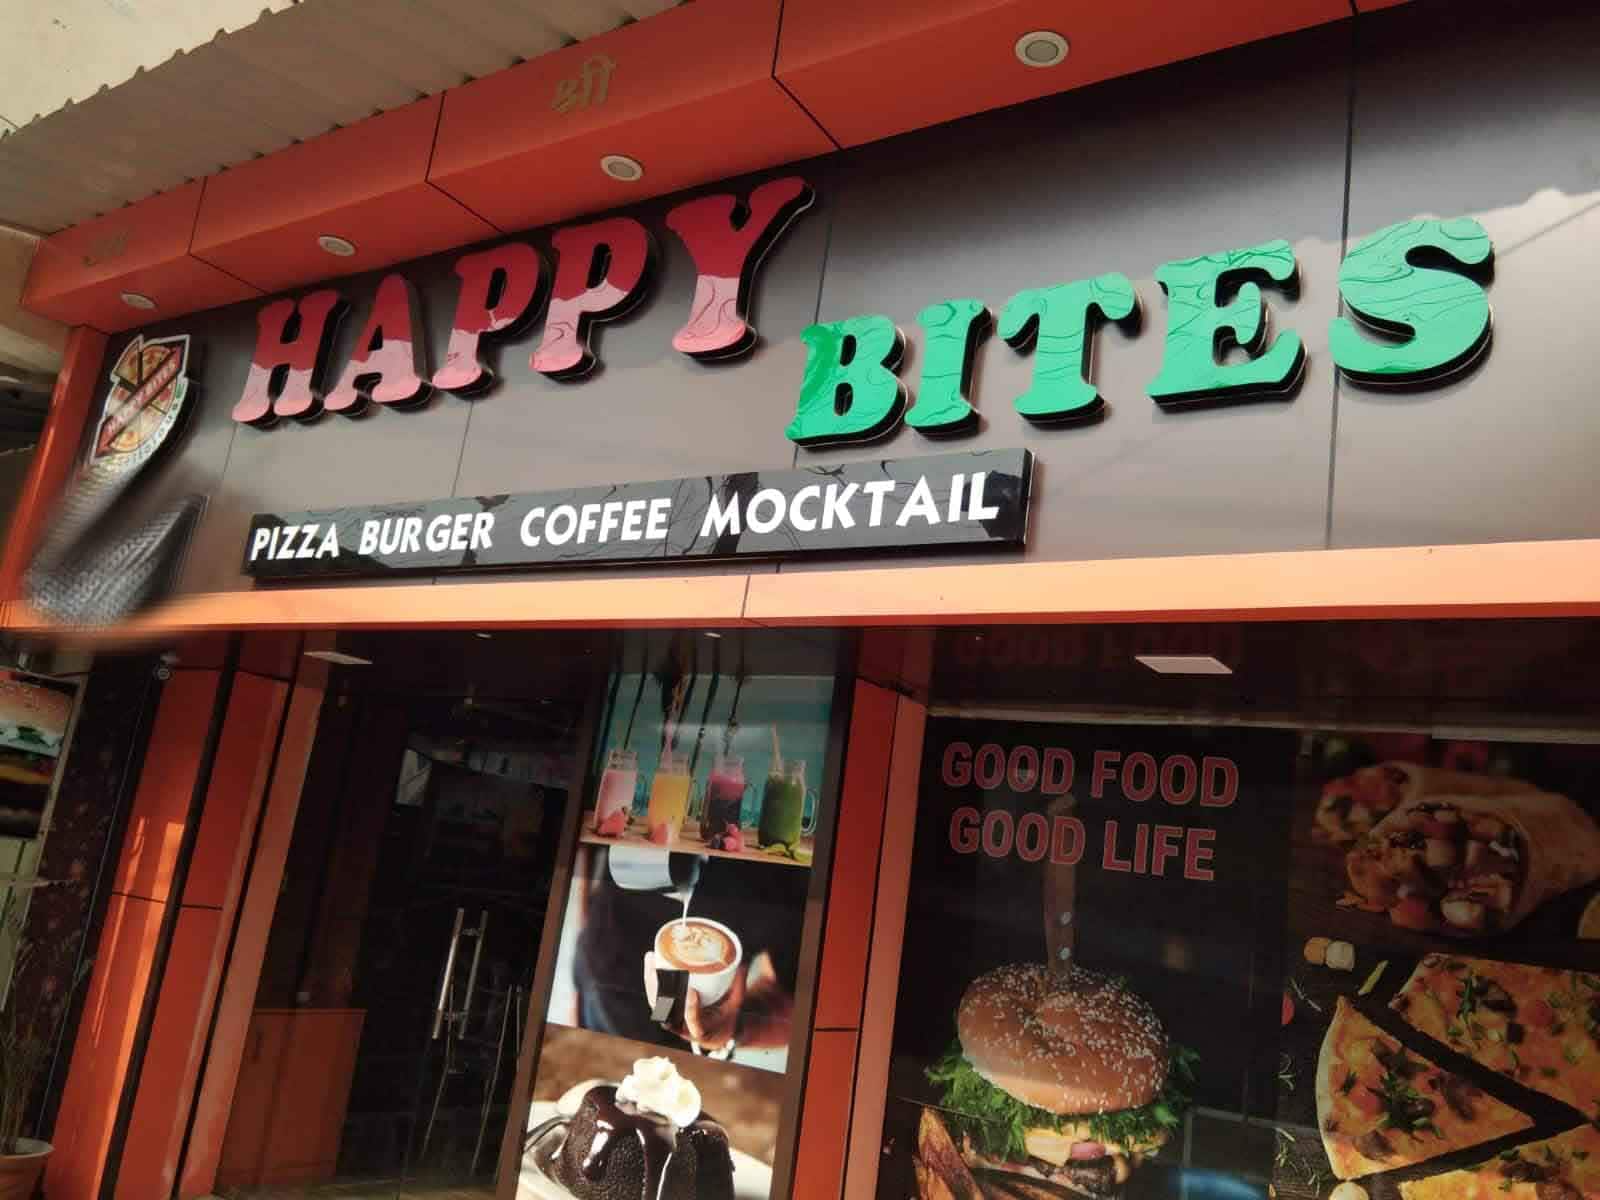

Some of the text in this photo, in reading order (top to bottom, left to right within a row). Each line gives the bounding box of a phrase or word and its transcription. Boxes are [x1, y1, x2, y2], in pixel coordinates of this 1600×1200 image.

[232, 176, 1495, 446] HAPPY BITES
[250, 471, 1000, 561] PIZZA BURGER COFFEE MOCKTAIL
[942, 742, 1240, 807] GOOD FOOD
[950, 807, 1217, 881] GOOD LIFE
